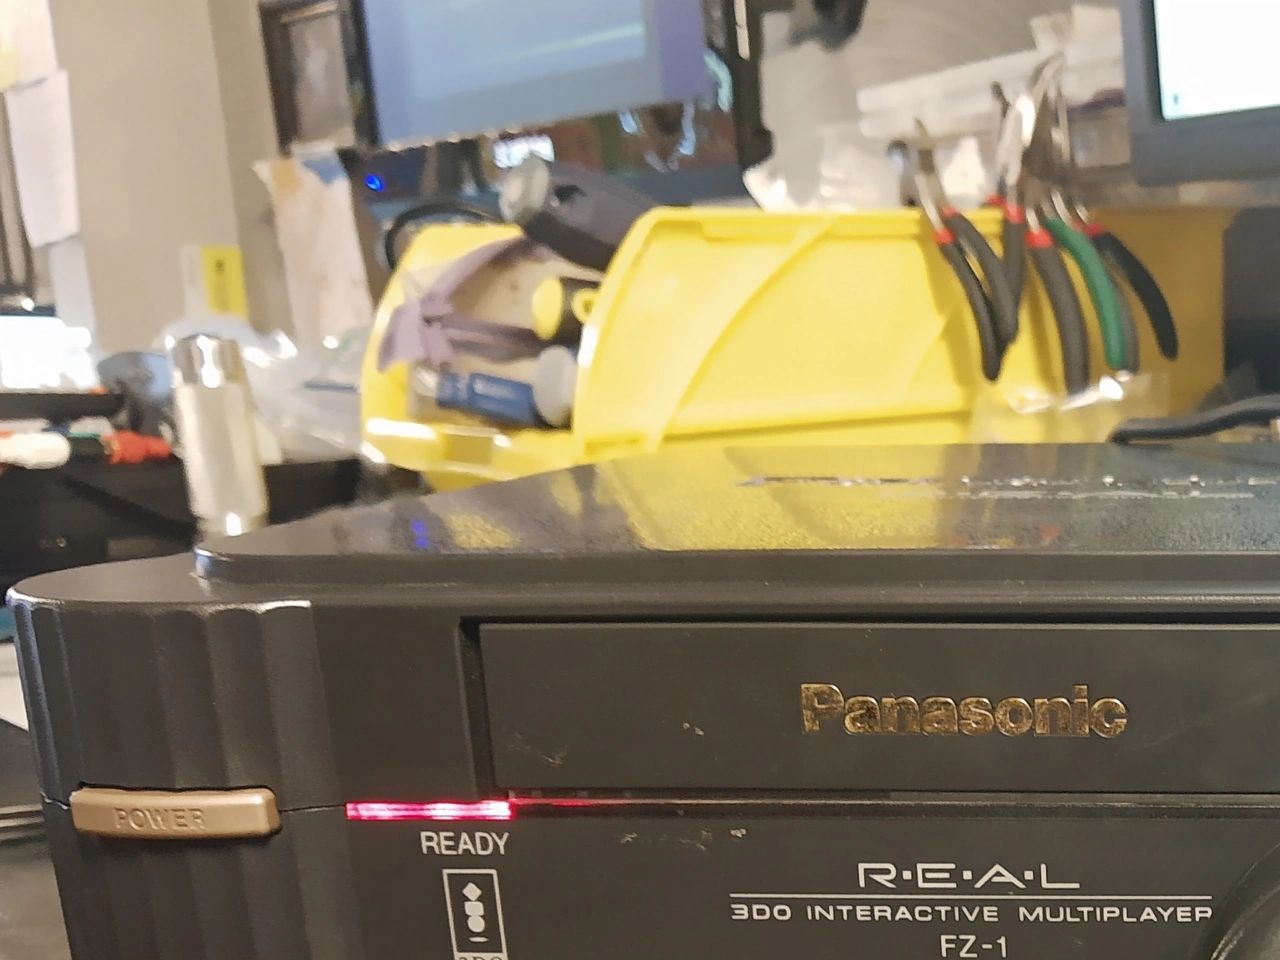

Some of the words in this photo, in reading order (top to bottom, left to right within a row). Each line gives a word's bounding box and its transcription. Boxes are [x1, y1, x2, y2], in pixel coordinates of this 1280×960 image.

[800, 683, 1128, 739] Panasonic
[114, 807, 206, 831] POWER
[420, 831, 510, 855] READY
[731, 904, 792, 920] 3DO
[806, 905, 999, 922] INTERACTIVE
[1019, 906, 1213, 922] MULTIPLAYER
[941, 935, 1007, 958] FZ-1
